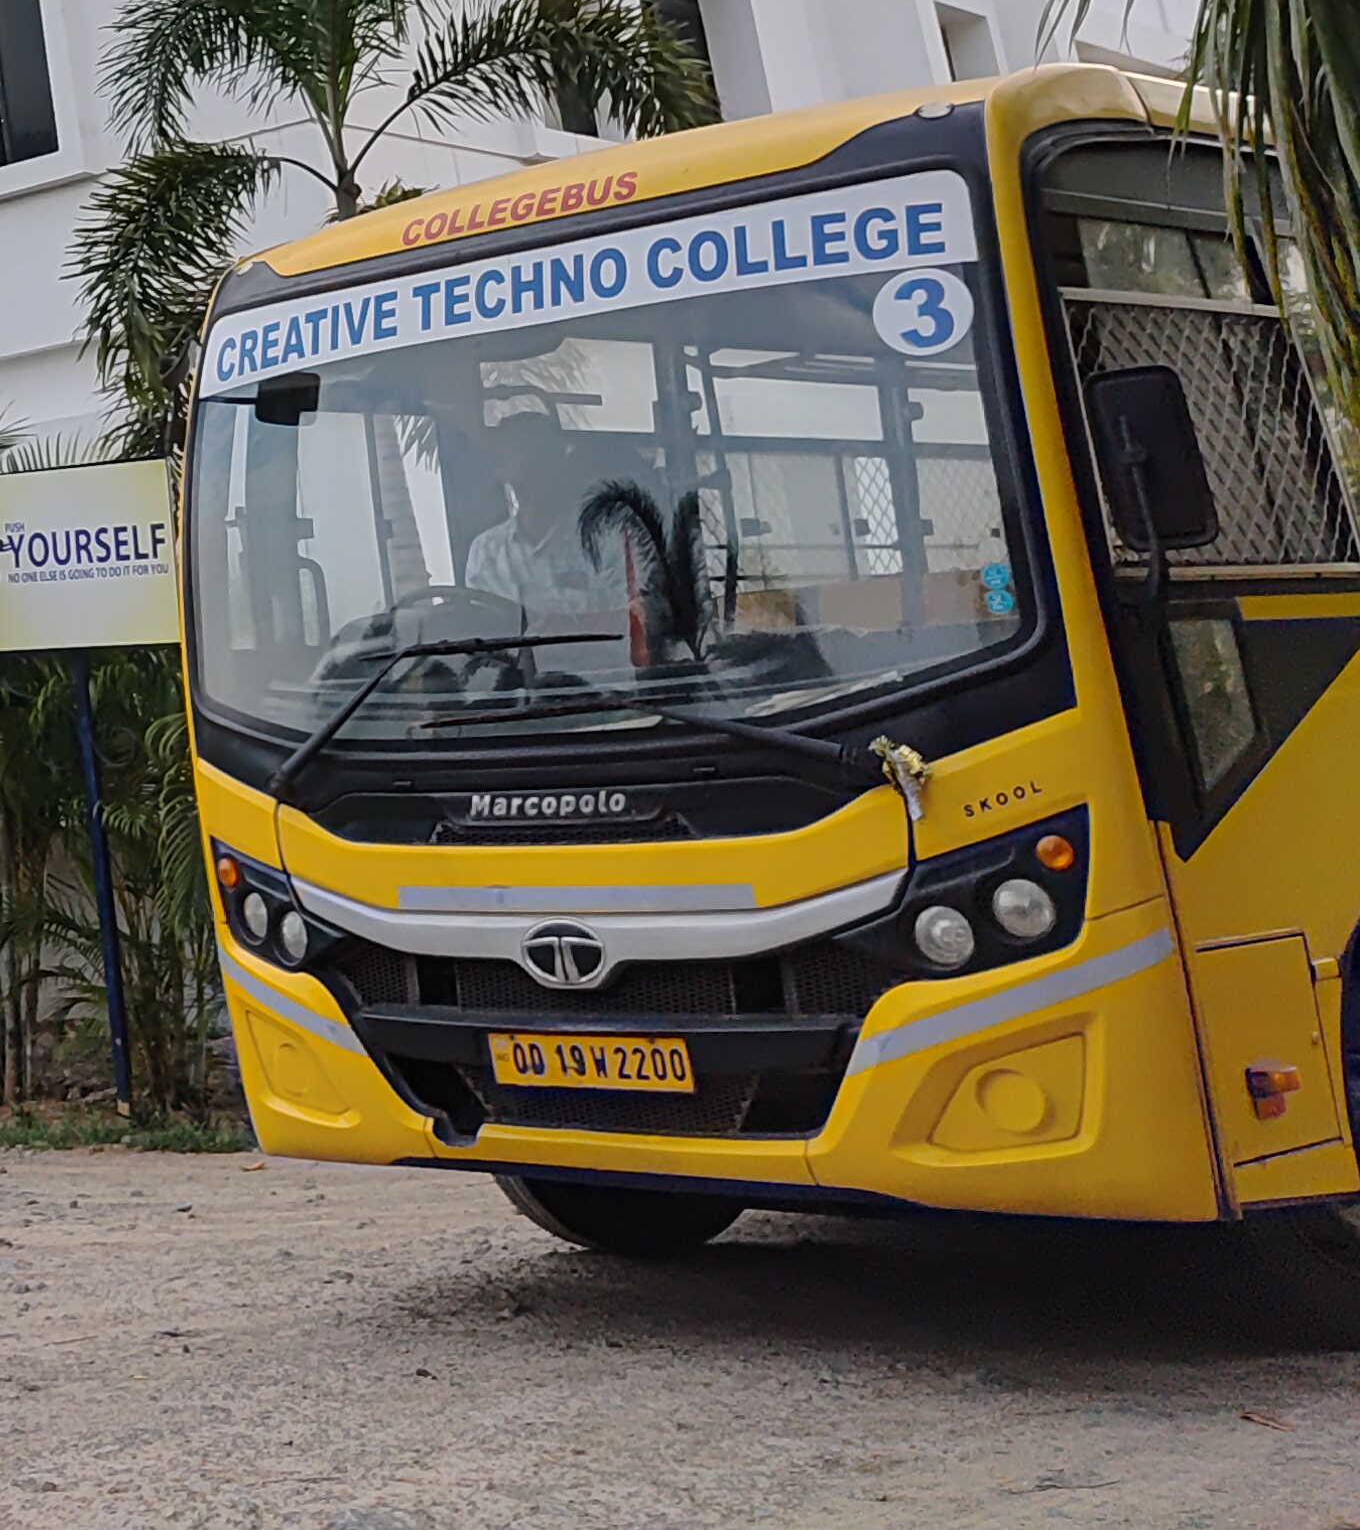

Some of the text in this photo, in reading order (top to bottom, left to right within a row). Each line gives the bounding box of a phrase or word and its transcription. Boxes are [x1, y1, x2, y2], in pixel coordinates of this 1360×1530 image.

[402, 171, 637, 246] COLLEGEBUS
[217, 202, 946, 382] CREATIVE TECHNO COLLEGE
[893, 278, 955, 348] 3
[5, 522, 25, 533] PUSH
[6, 523, 166, 568] YOURSELF
[8, 563, 169, 584] NO ONE ELSE IS GOING TO DO IT FOR YOU
[470, 790, 626, 817] Marcopolo
[963, 780, 1042, 818] SKOOL
[613, 1047, 686, 1081] 2200
